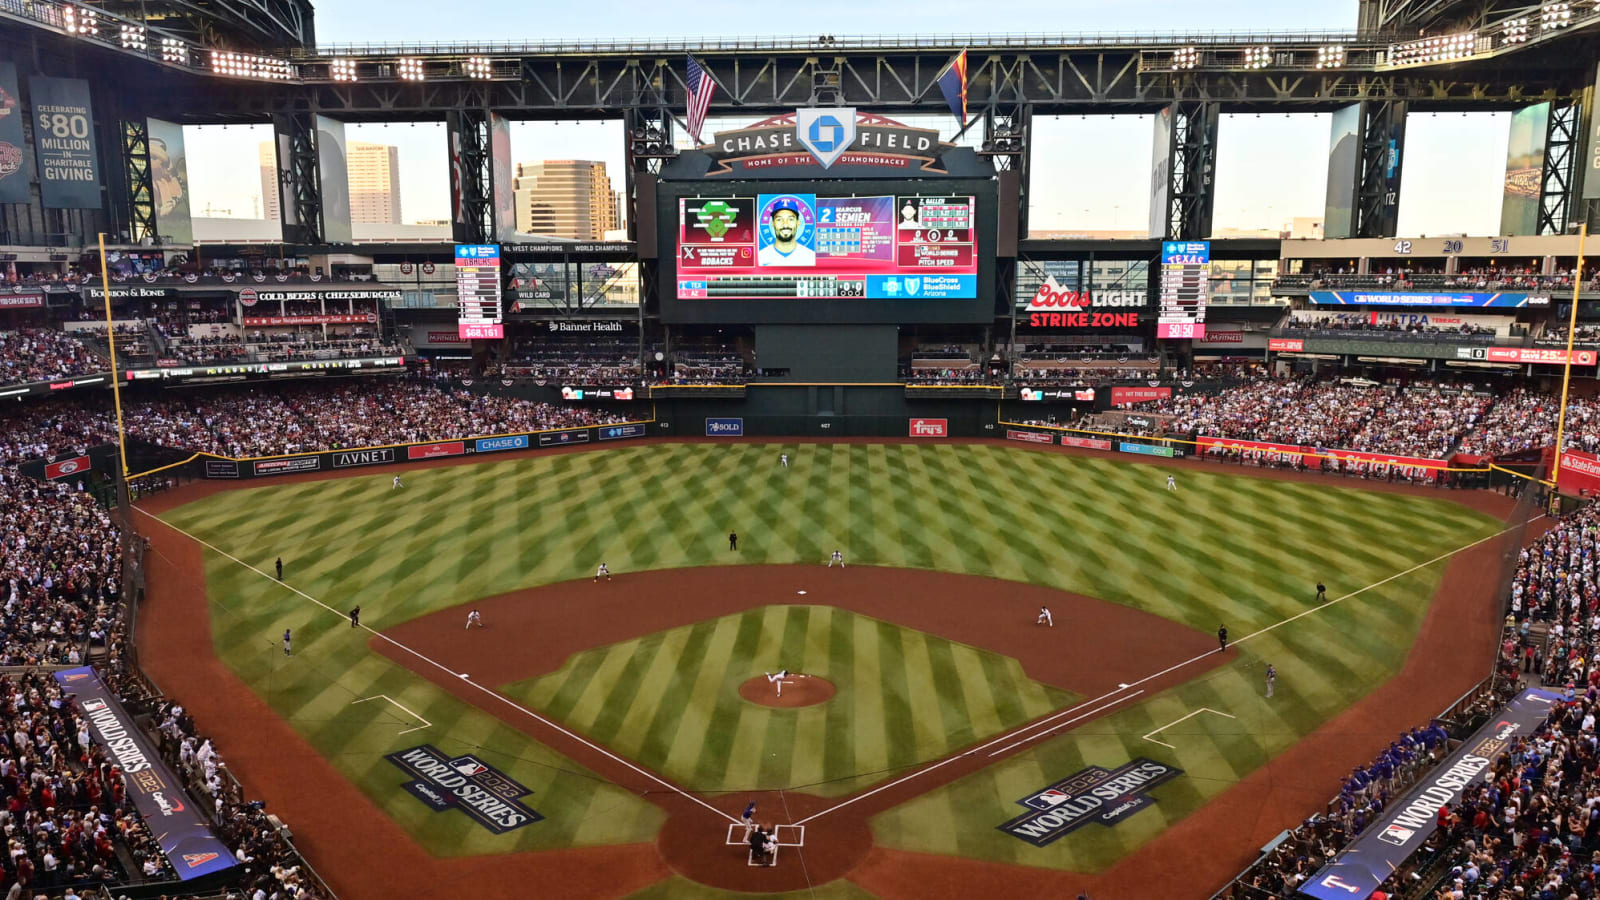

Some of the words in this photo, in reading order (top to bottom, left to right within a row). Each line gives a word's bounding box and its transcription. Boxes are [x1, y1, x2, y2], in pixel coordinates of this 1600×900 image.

[37, 105, 87, 114] CELEBRATING
[40, 114, 89, 138] $80
[41, 138, 91, 150] MILLION
[722, 132, 793, 153] CHASE
[861, 132, 931, 151] FIELD
[62, 150, 73, 158] IN
[44, 159, 92, 167] CHARITABLE
[747, 158, 772, 167] HOME
[841, 156, 906, 166] DIAMONDBACKS
[45, 168, 94, 181] GIVING
[821, 208, 831, 222] 2
[836, 212, 871, 222] SEMIEN
[1394, 241, 1412, 254] 42
[1443, 240, 1463, 253] 20
[1491, 239, 1509, 253] 51
[1168, 255, 1204, 264] TEXAS
[140, 289, 165, 297] BONES
[259, 292, 284, 300] COLD
[286, 292, 316, 300] BEERS
[325, 291, 400, 299] CHEESEBURGERS
[1031, 284, 1091, 307] Coors
[1092, 290, 1147, 307] LIGHT
[1368, 295, 1400, 303] WORLD
[1400, 295, 1433, 303] SERIES
[560, 322, 591, 331] Banner
[593, 322, 622, 331] Health
[1030, 312, 1088, 327] STRIKE
[1091, 312, 1139, 327] ZONE
[914, 420, 943, 435] fry's
[482, 439, 512, 449] CHASE
[340, 451, 388, 465] AVNET
[89, 707, 128, 742] WORLD
[107, 737, 151, 772] SERIES
[136, 770, 160, 793] 2023
[402, 749, 467, 788] WORLD
[452, 784, 527, 827] SERIES
[475, 772, 519, 798] 2023
[1060, 770, 1109, 794] 2023
[1398, 787, 1455, 829] WORLD
[1435, 753, 1490, 791] SERIES
[1475, 739, 1501, 759] 2023
[1012, 795, 1103, 838] WORLD
[1092, 762, 1167, 800] SERIES
